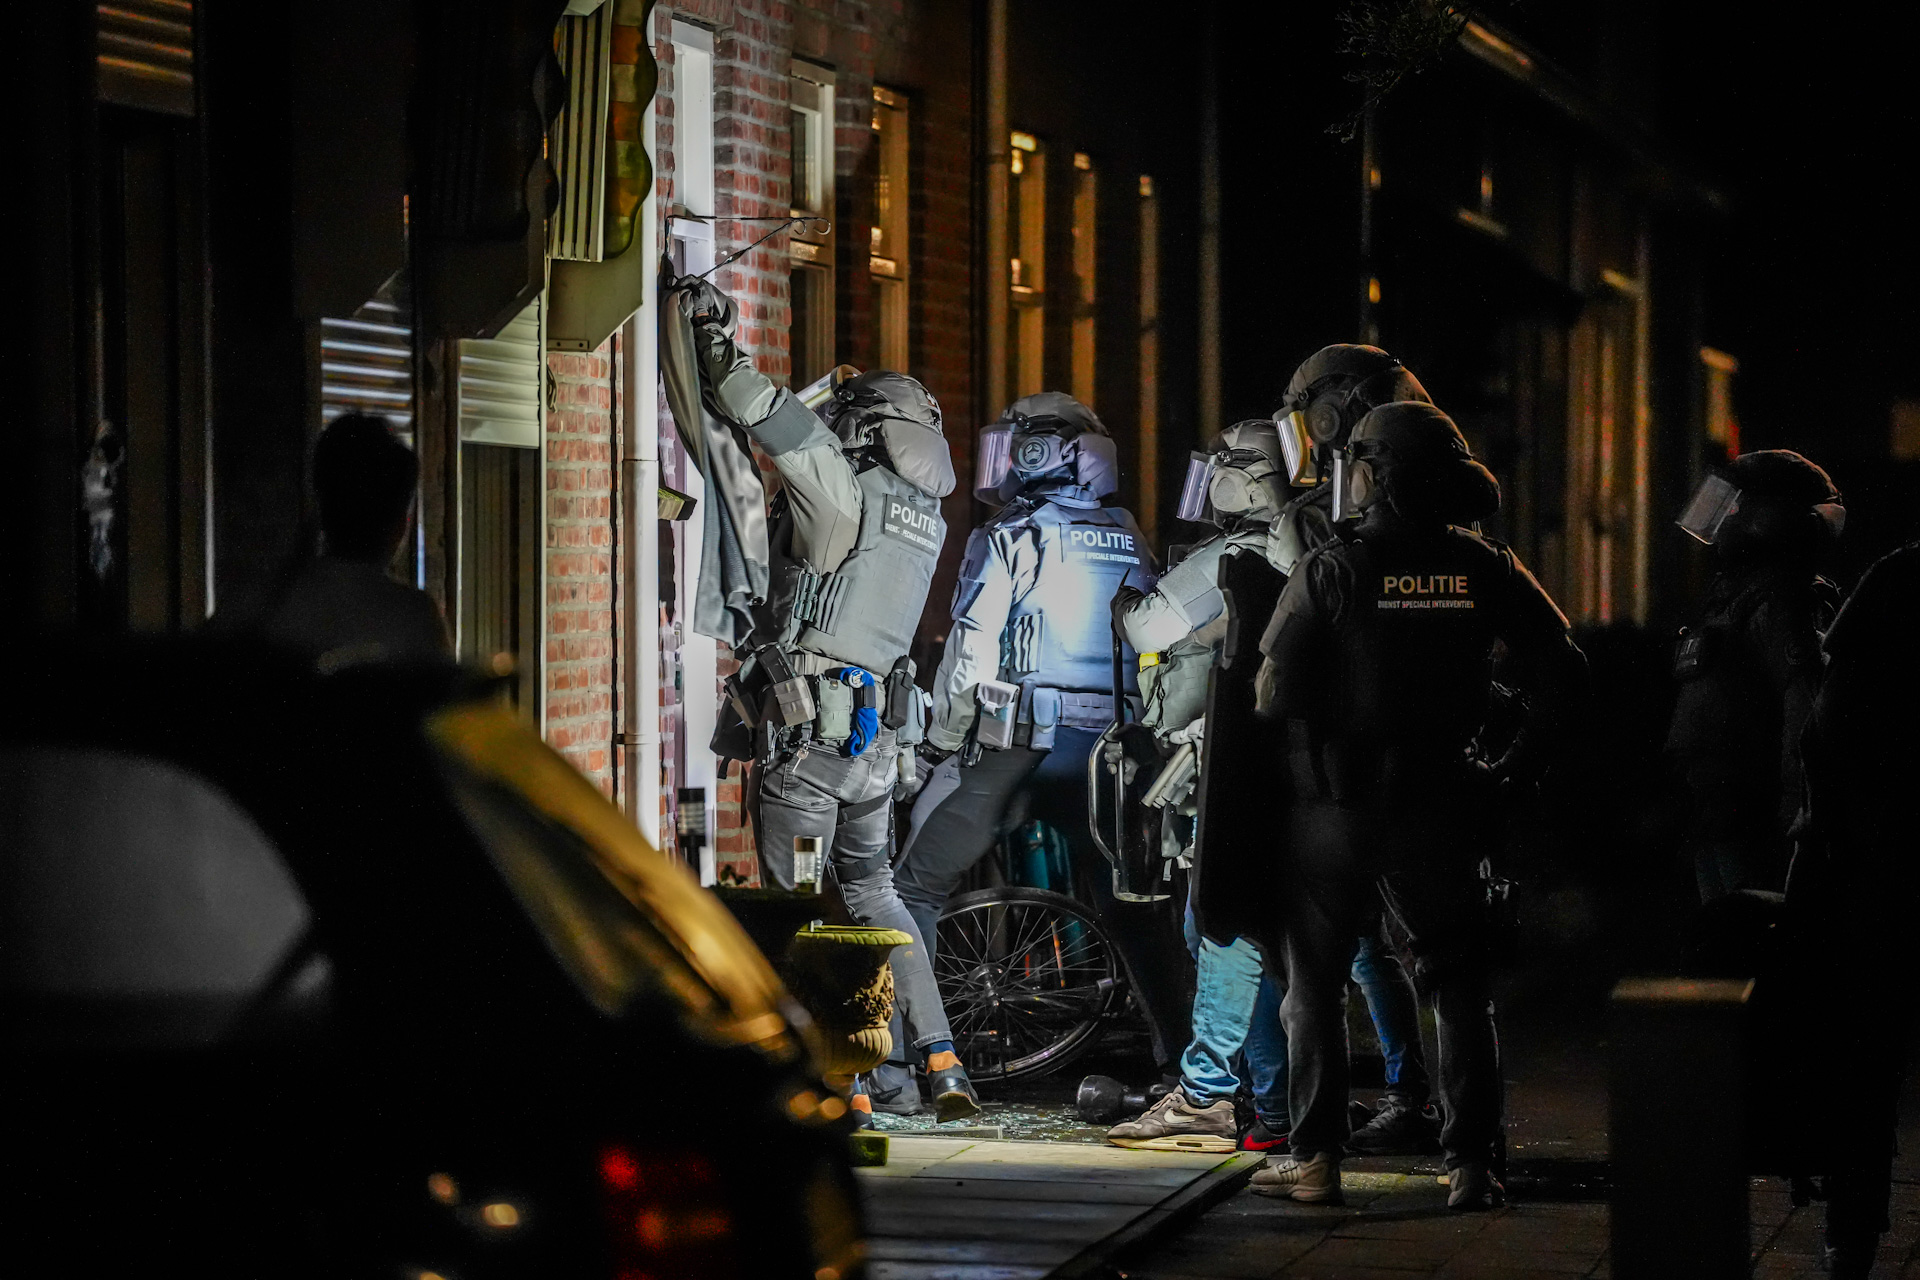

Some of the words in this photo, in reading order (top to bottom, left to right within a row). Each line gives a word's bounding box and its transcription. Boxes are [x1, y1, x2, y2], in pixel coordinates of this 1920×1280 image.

[890, 502, 937, 537] POLITIE
[1070, 530, 1135, 551] POLITIE
[1383, 575, 1468, 594] POLITIE
[1377, 600, 1400, 609] DIENST
[1401, 600, 1430, 609] SPECIALE
[1431, 600, 1474, 609] INTERVENTIES
